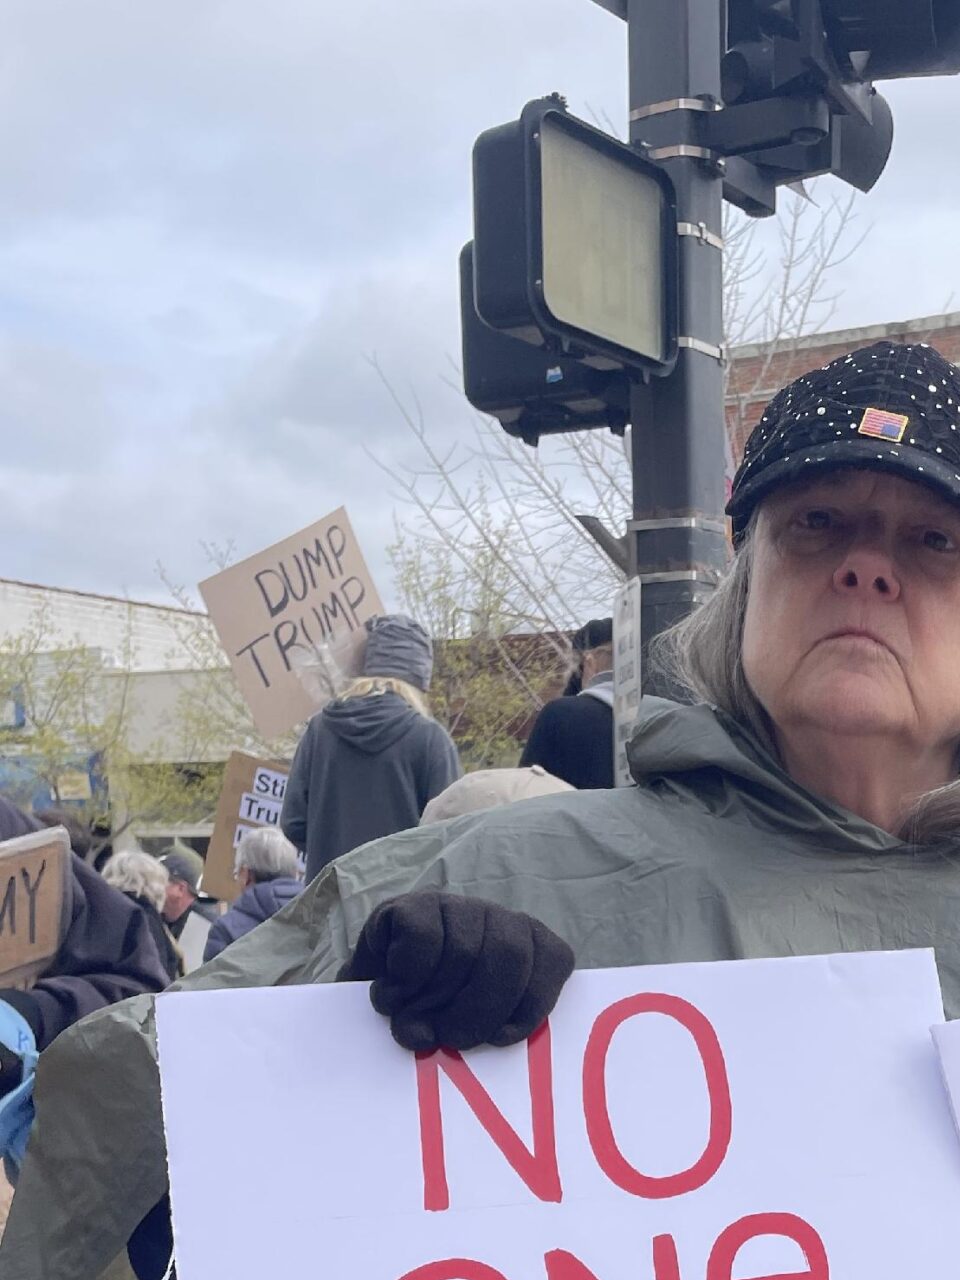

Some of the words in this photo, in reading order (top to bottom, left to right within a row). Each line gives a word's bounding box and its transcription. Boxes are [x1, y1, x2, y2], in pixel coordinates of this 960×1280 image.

[254, 524, 346, 618] DUMP
[236, 576, 365, 688] TRUMP
[415, 992, 733, 1212] NO
